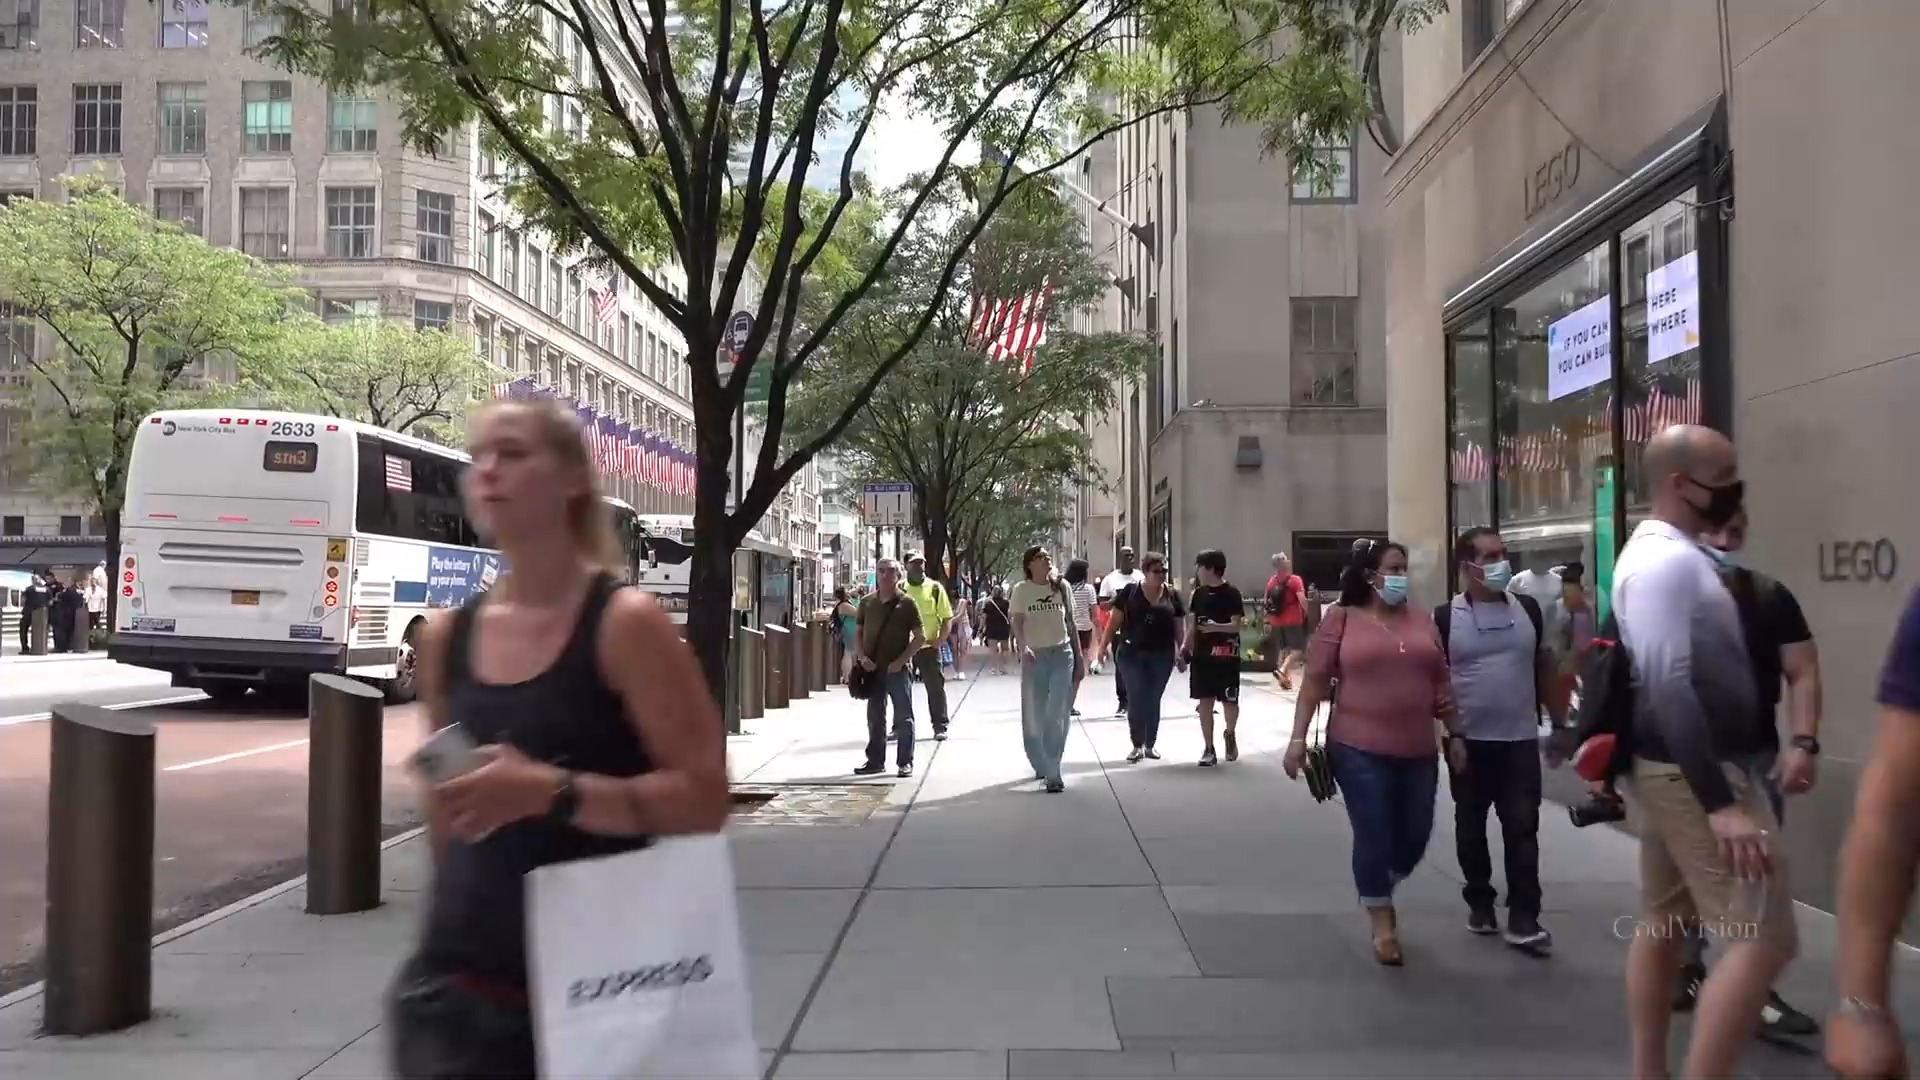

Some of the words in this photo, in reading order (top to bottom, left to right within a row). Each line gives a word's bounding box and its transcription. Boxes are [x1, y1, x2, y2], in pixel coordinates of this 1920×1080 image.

[1522, 143, 1580, 222] LEGO
[1651, 287, 1677, 312] HERE
[1563, 334, 1571, 351] IF
[1573, 328, 1589, 348] YOU
[1591, 320, 1609, 339] CAN
[1558, 355, 1573, 375] YOU
[1575, 350, 1592, 368] CAN
[208, 426, 221, 435] City
[271, 421, 315, 437] 2633
[431, 556, 443, 573] Play
[444, 557, 453, 570] the
[453, 557, 471, 574] lottery
[1819, 538, 1897, 583] LEGO
[430, 576, 437, 586] on
[437, 576, 450, 589] your
